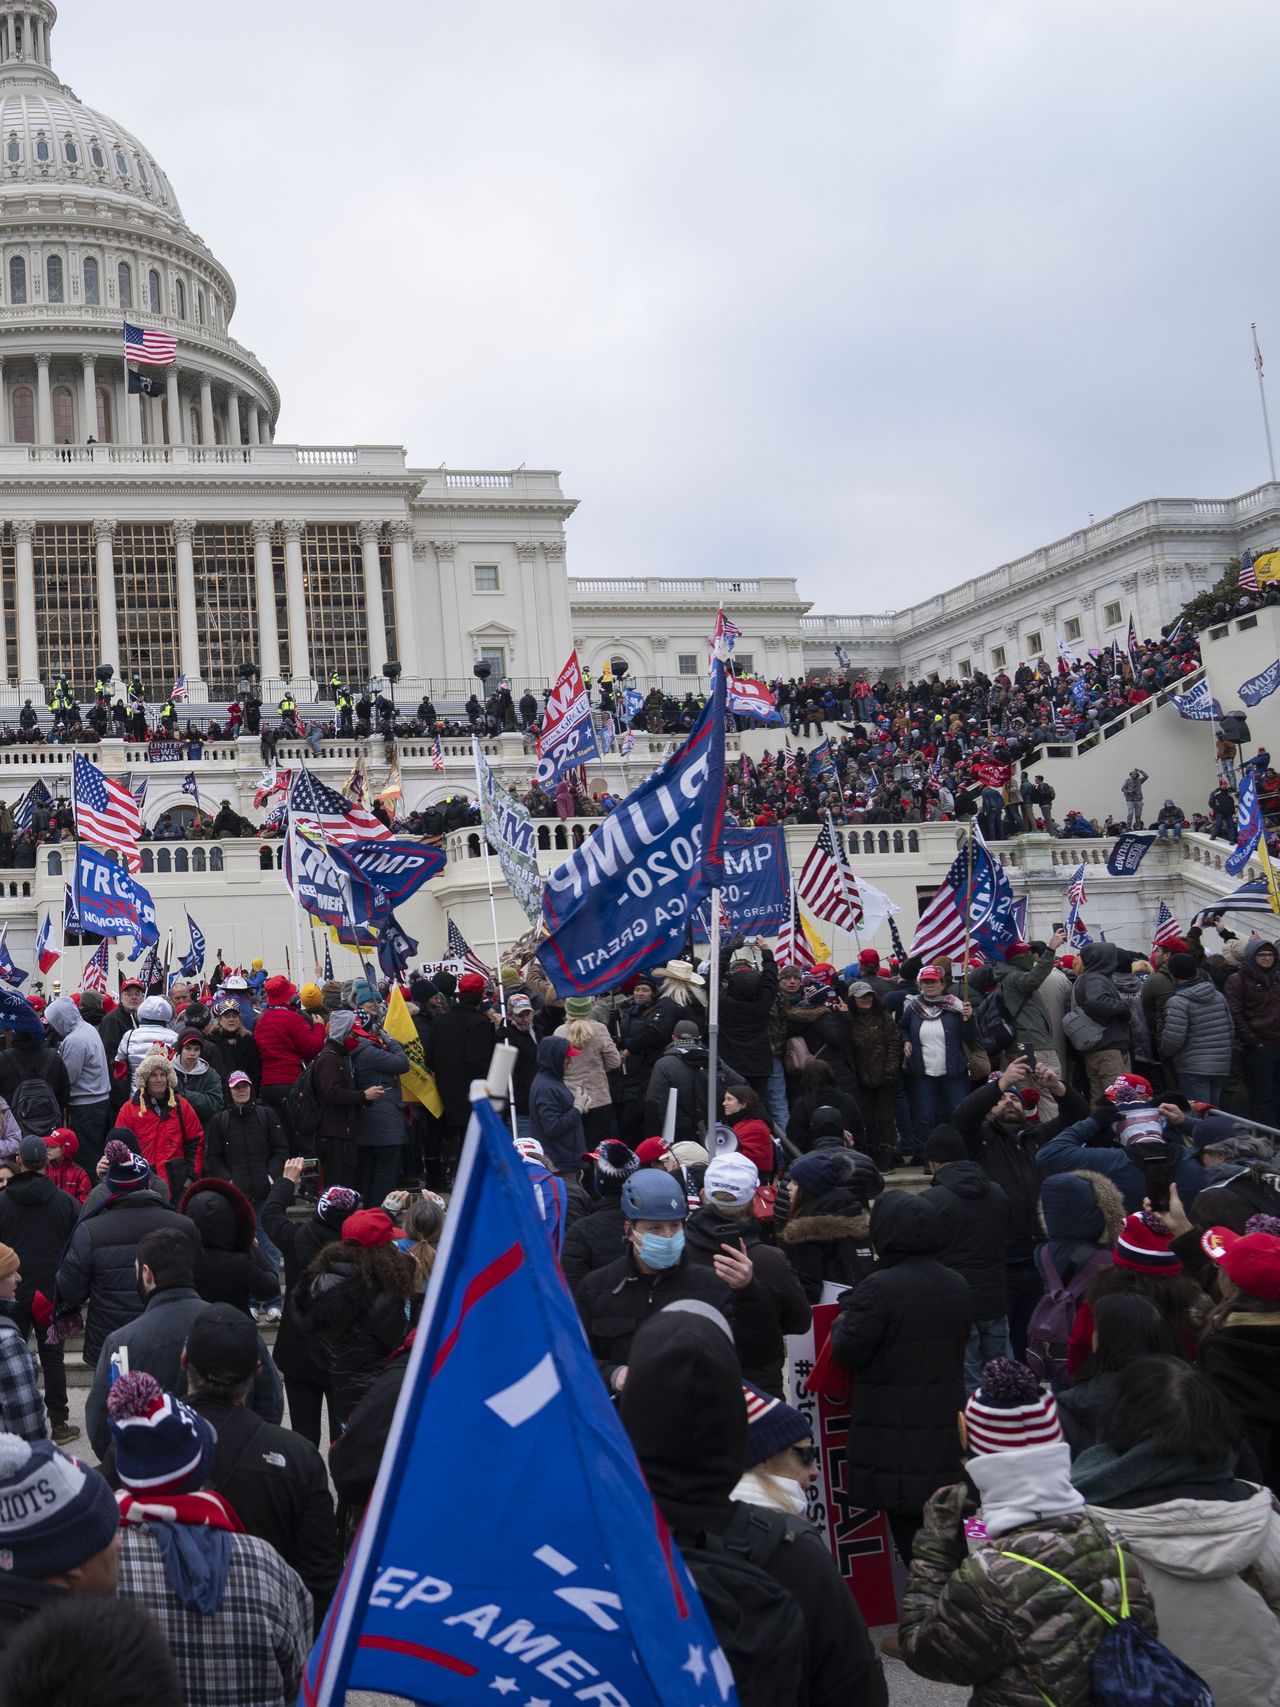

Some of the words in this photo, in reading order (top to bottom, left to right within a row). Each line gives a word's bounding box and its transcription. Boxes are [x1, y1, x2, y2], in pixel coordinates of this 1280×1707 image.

[1113, 837, 1136, 871] TRUMP
[744, 903, 784, 918] GREAT!
[423, 963, 459, 974] Biden
[368, 1565, 453, 1610] EP
